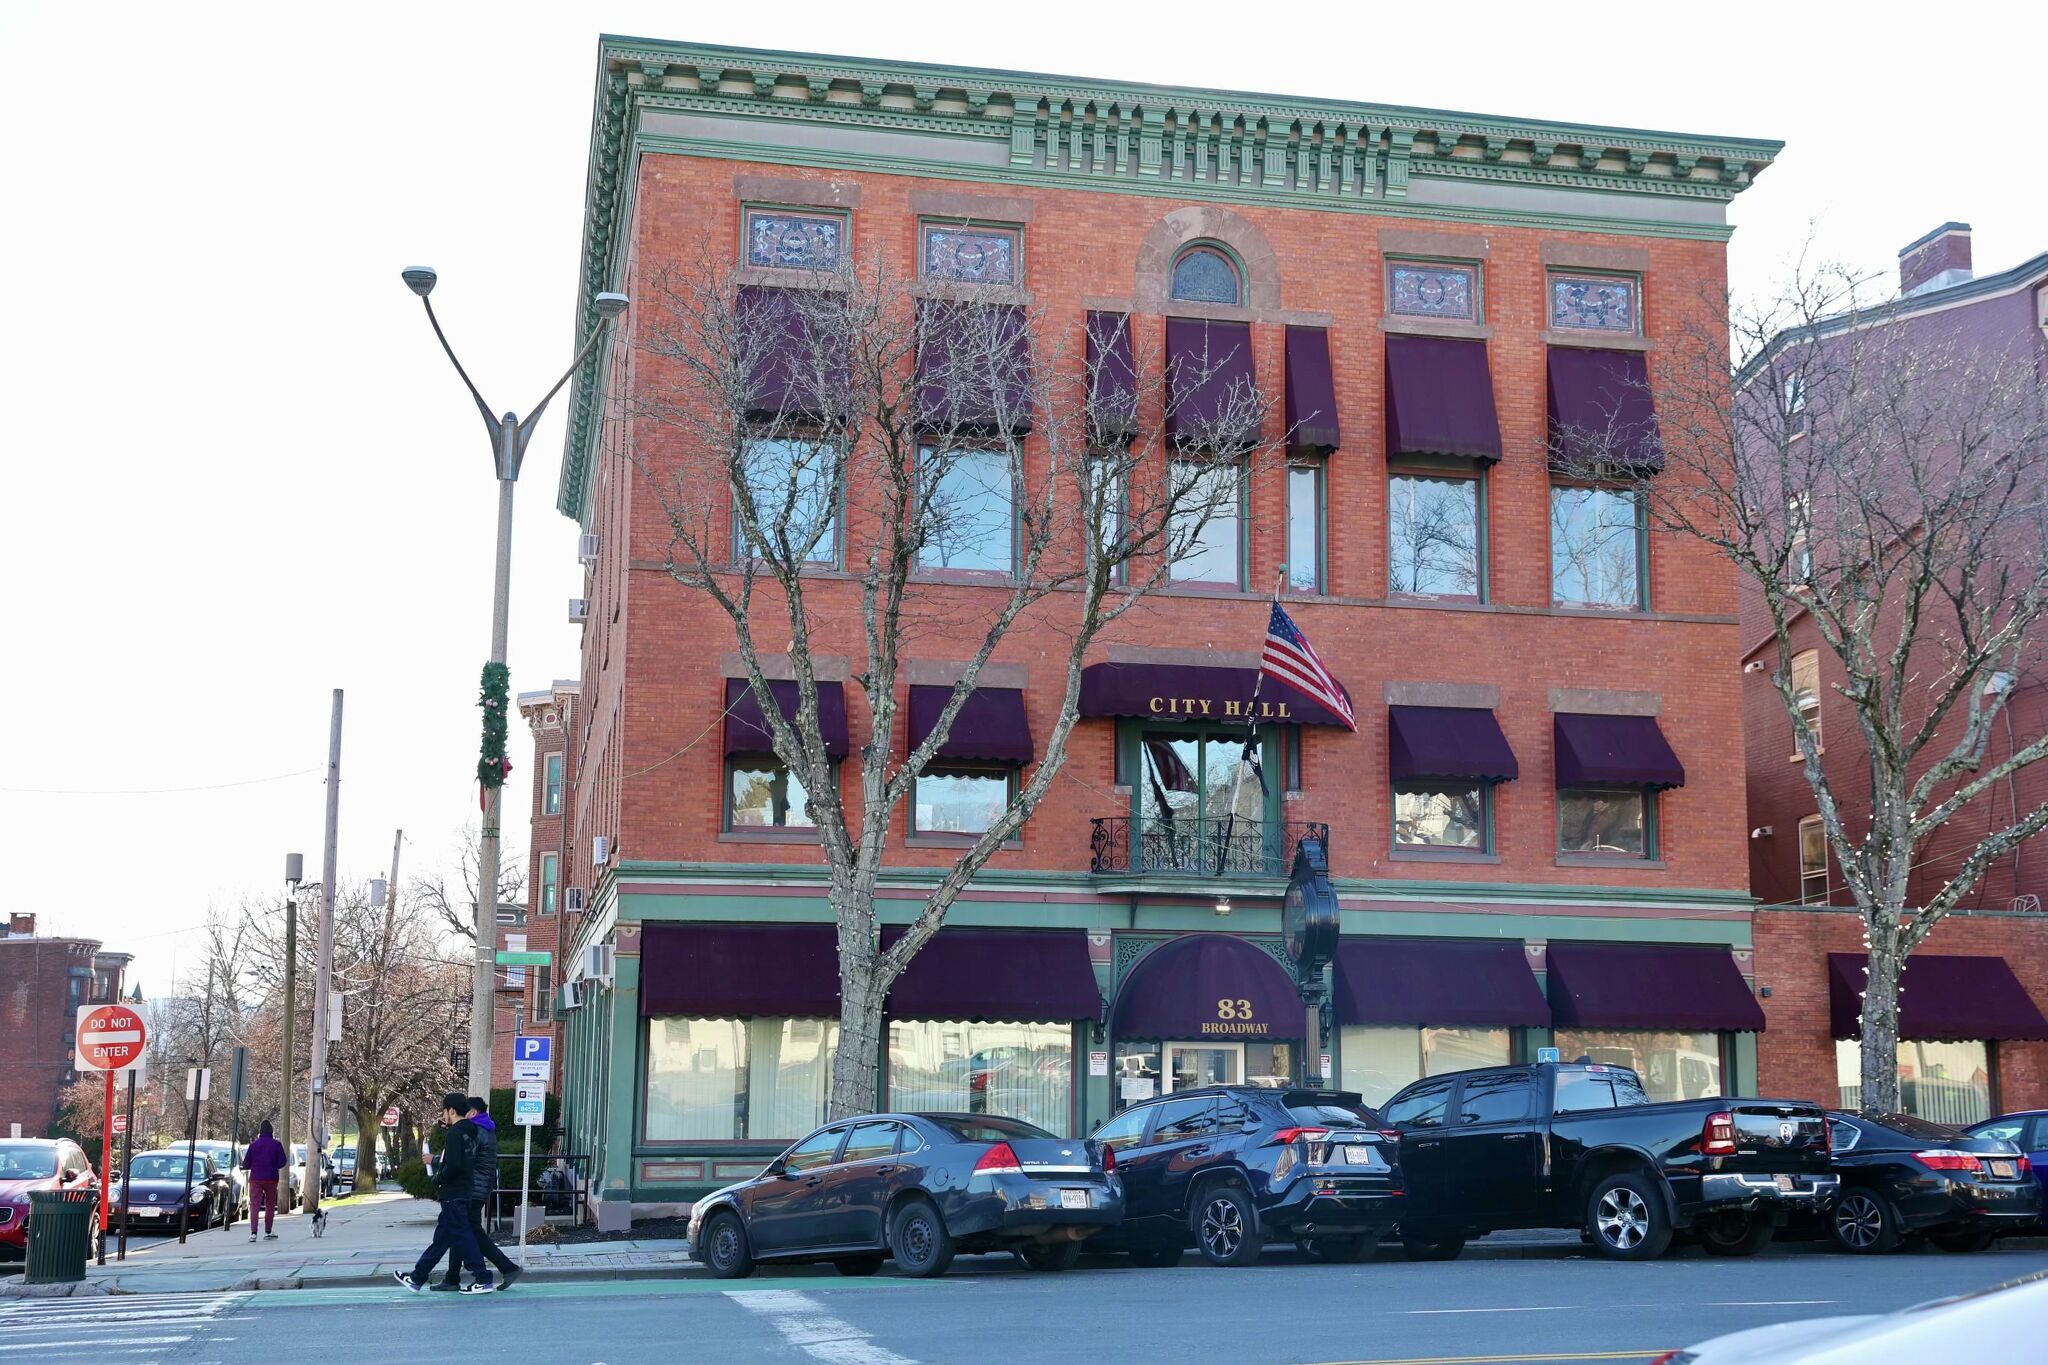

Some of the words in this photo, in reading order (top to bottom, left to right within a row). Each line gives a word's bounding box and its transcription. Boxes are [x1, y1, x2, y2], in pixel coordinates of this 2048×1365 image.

[1149, 697, 1212, 714] CITY
[1224, 700, 1291, 718] HALL
[1217, 998, 1253, 1020] 83
[91, 1018, 106, 1029] DO
[111, 1017, 133, 1028] NOT
[1201, 1022, 1269, 1034] BROADWAY
[93, 1046, 129, 1058] ENTER
[525, 1039, 540, 1059] P
